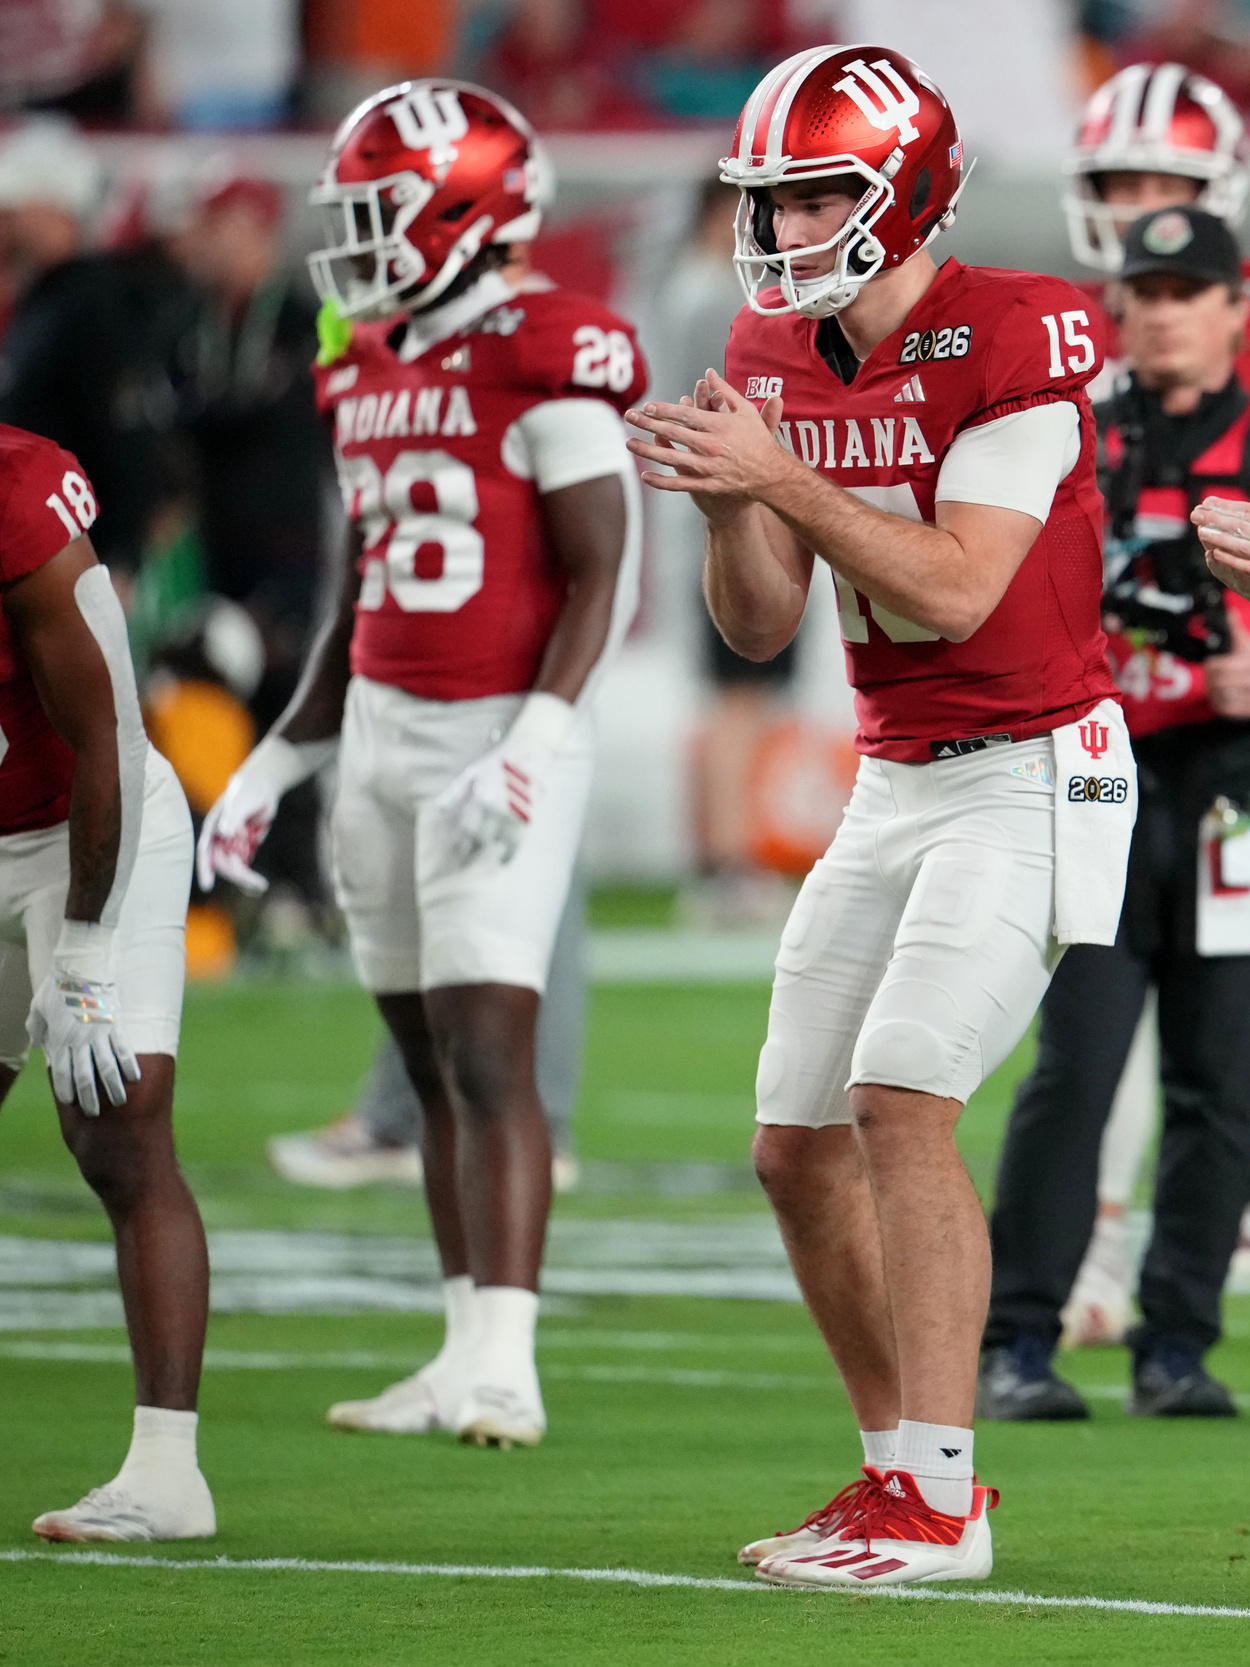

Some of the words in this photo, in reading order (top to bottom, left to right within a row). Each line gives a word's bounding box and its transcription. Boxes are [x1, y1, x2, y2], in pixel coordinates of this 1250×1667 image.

[572, 325, 634, 393] 28
[1041, 309, 1096, 378] 15
[337, 385, 477, 447] NDIANA
[775, 417, 935, 469] NDIANA
[45, 470, 97, 542] 18
[1068, 775, 1127, 803] 2026
